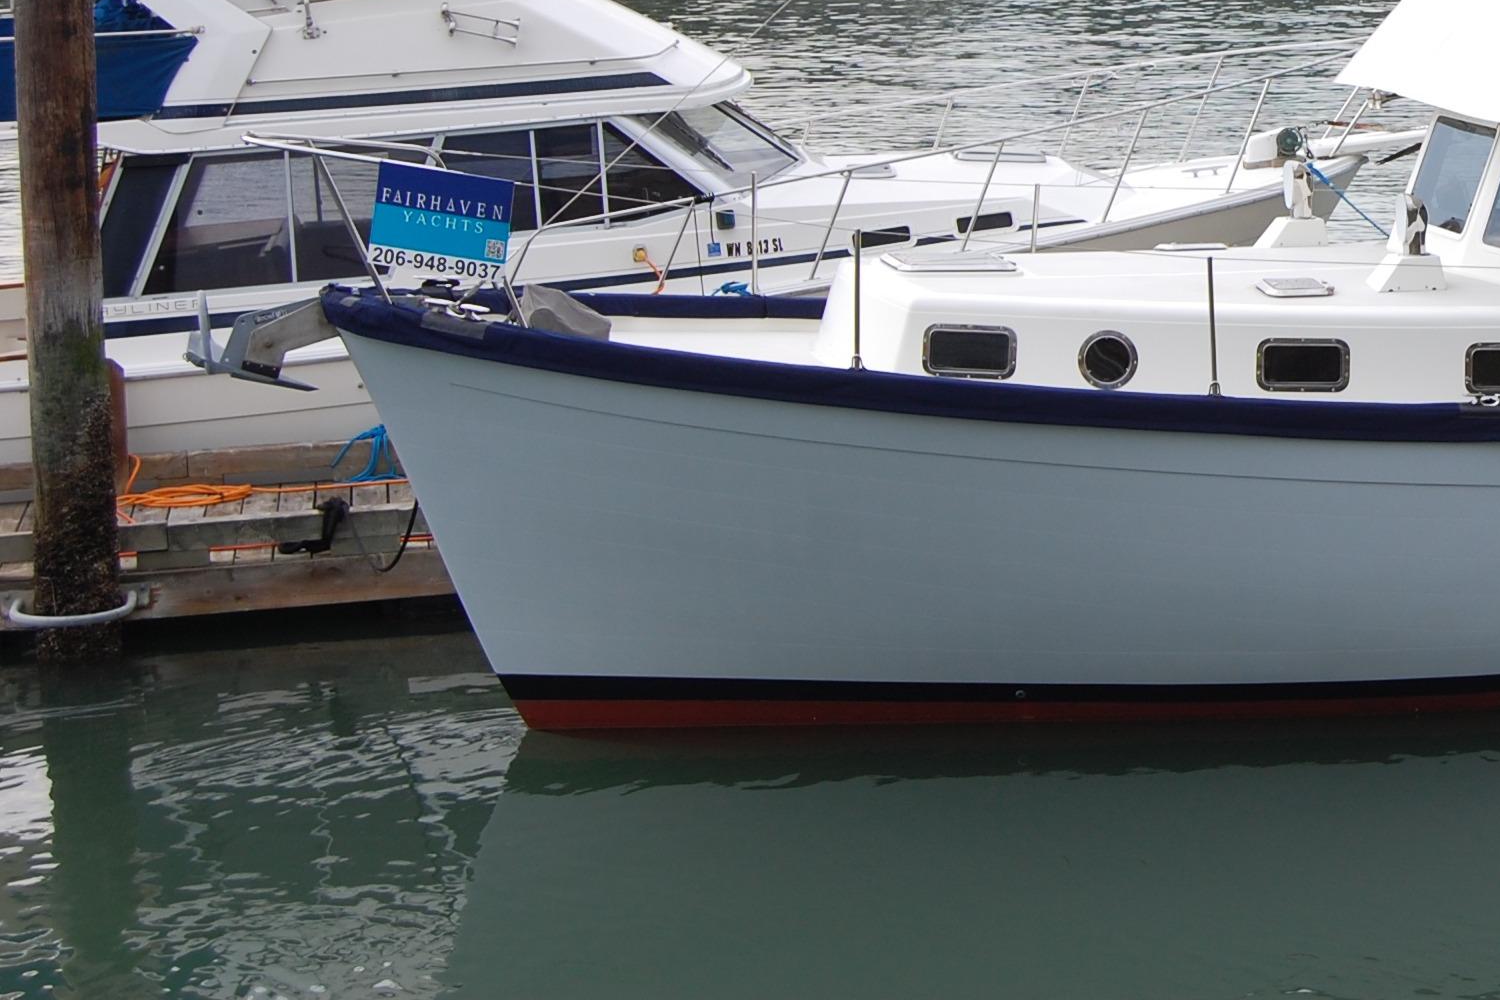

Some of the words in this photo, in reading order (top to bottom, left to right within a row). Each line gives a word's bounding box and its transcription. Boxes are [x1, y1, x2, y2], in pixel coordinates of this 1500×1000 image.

[381, 187, 503, 220] FAIRHAVEN
[403, 210, 484, 233] YACHTS
[726, 242, 741, 257] WN
[746, 239, 769, 255] 813
[372, 247, 500, 280] 206-948-9037
